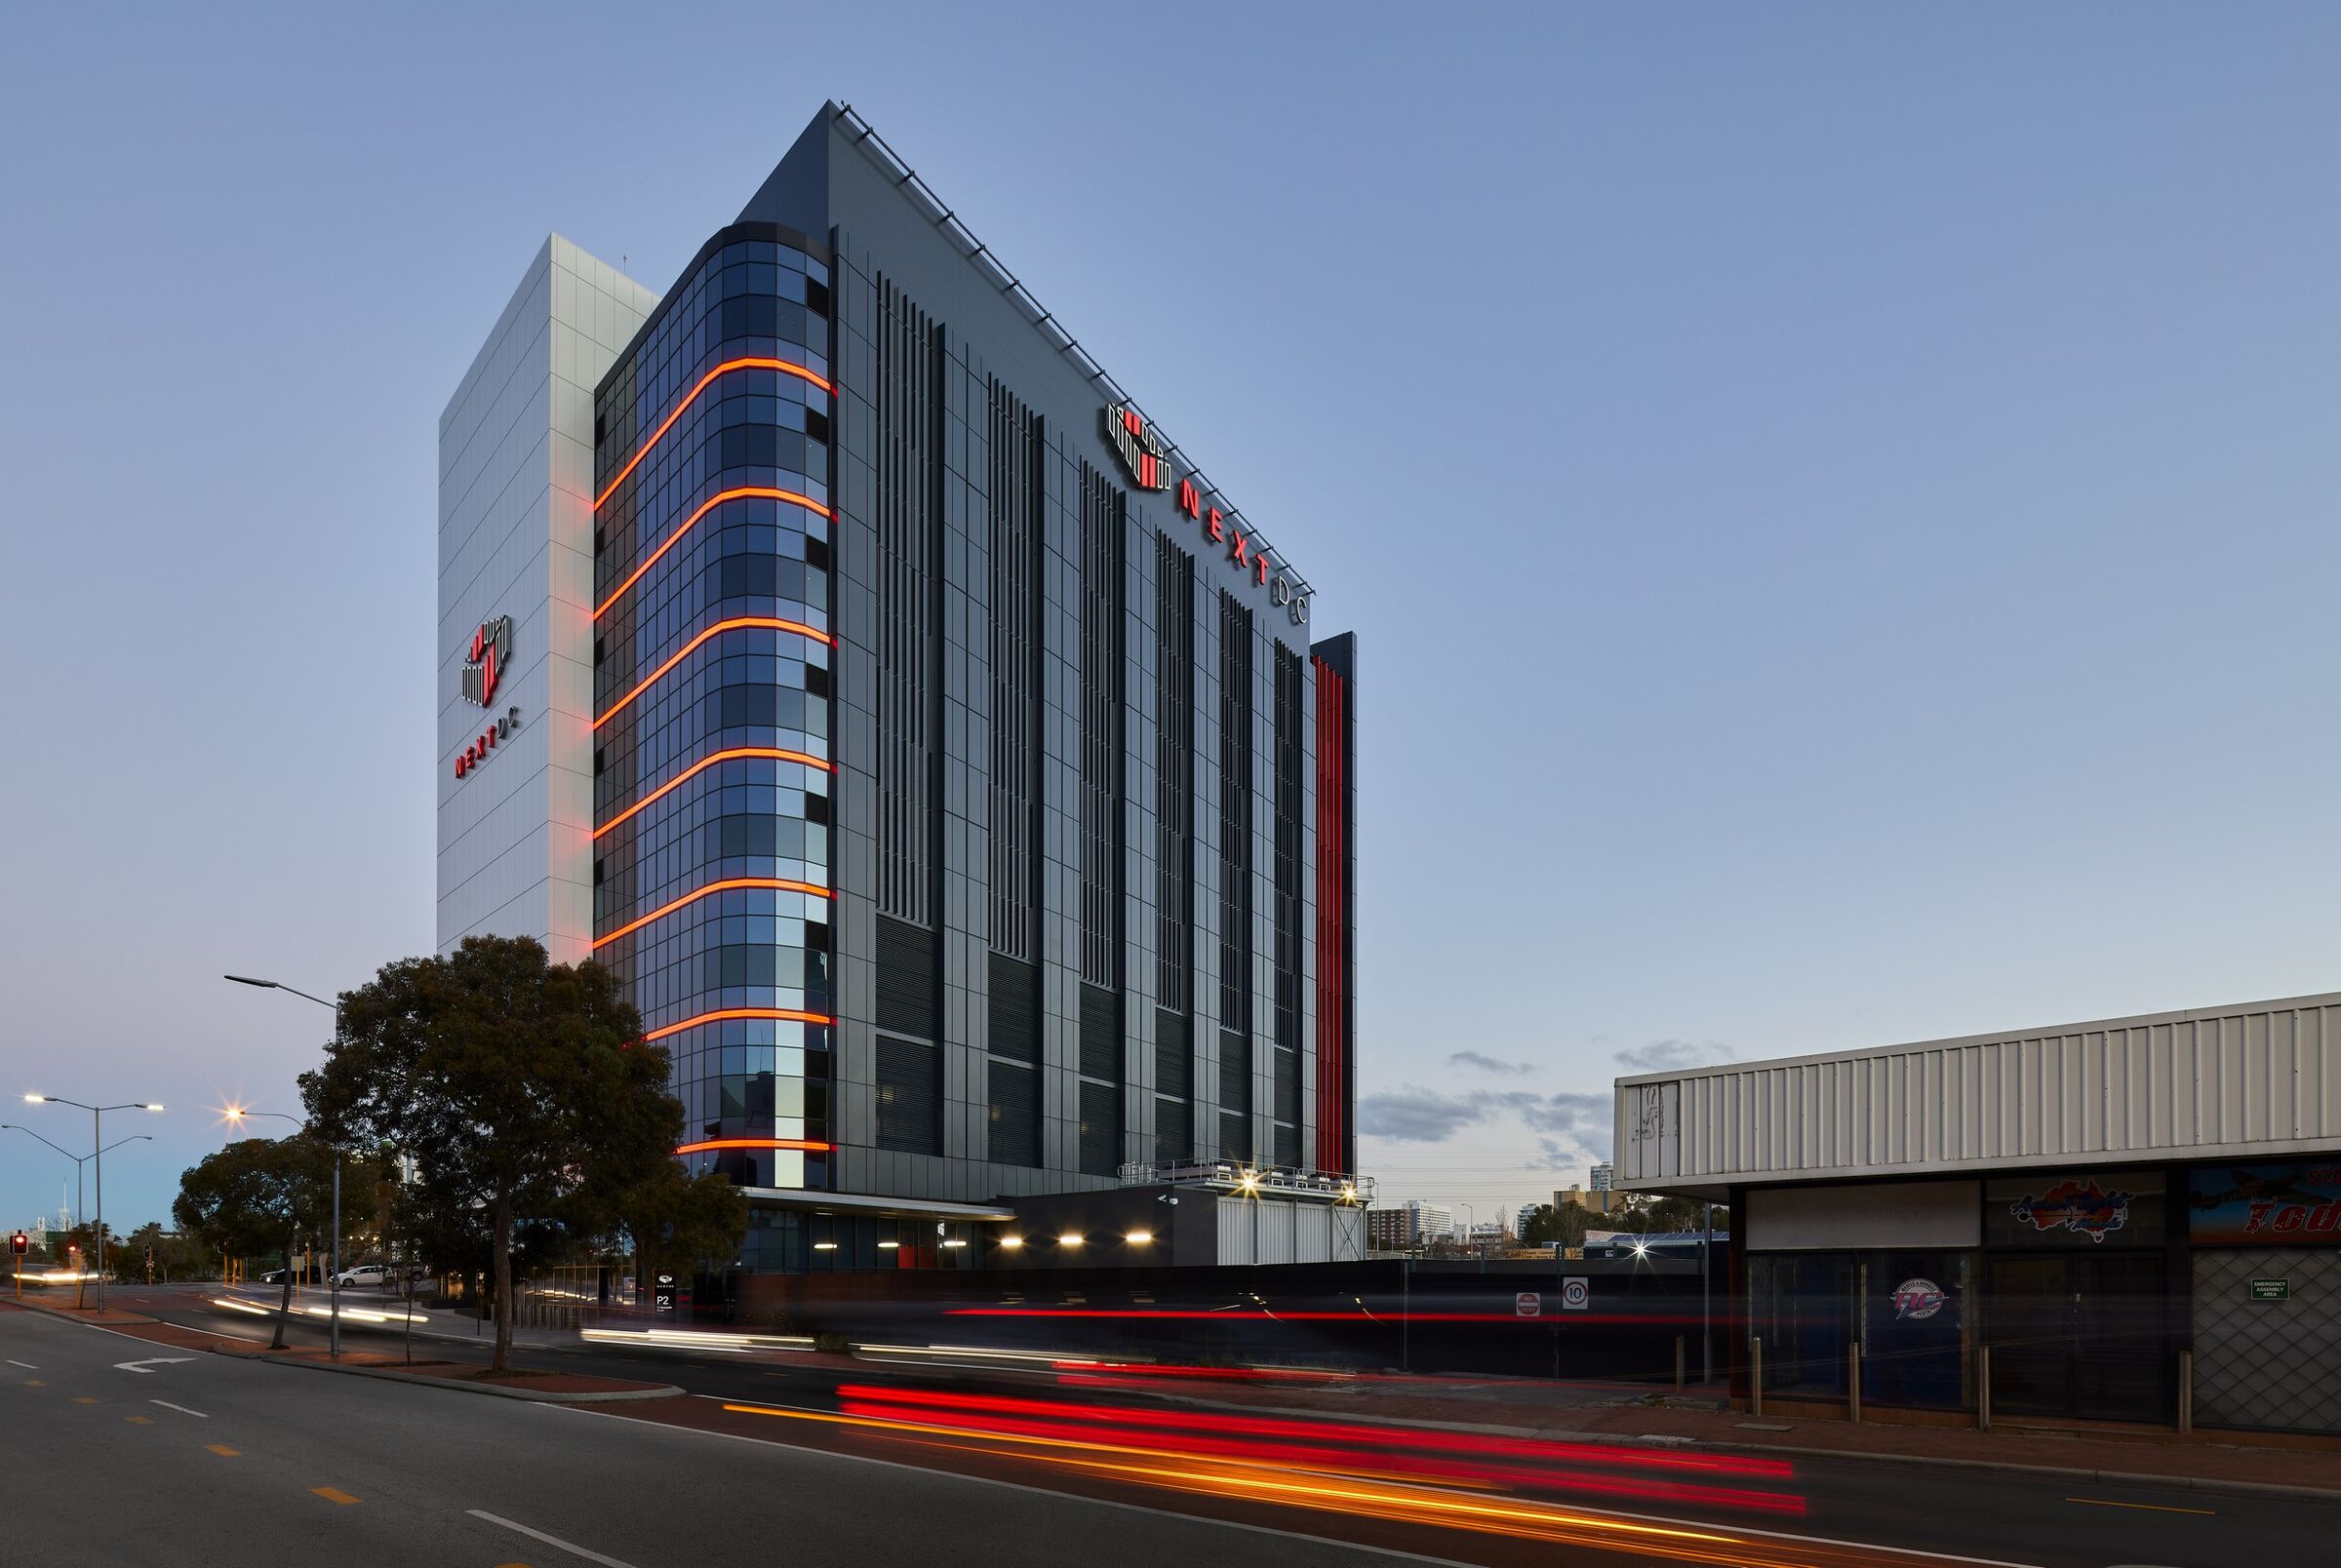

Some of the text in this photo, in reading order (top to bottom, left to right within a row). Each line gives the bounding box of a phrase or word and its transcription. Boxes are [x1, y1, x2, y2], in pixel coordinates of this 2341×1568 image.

[1180, 478, 1307, 624] NEXTDC
[455, 705, 520, 779] NEXTDC
[2242, 1197, 2341, 1234] Tod
[656, 1295, 669, 1305] P2
[1569, 1287, 1582, 1299] 10
